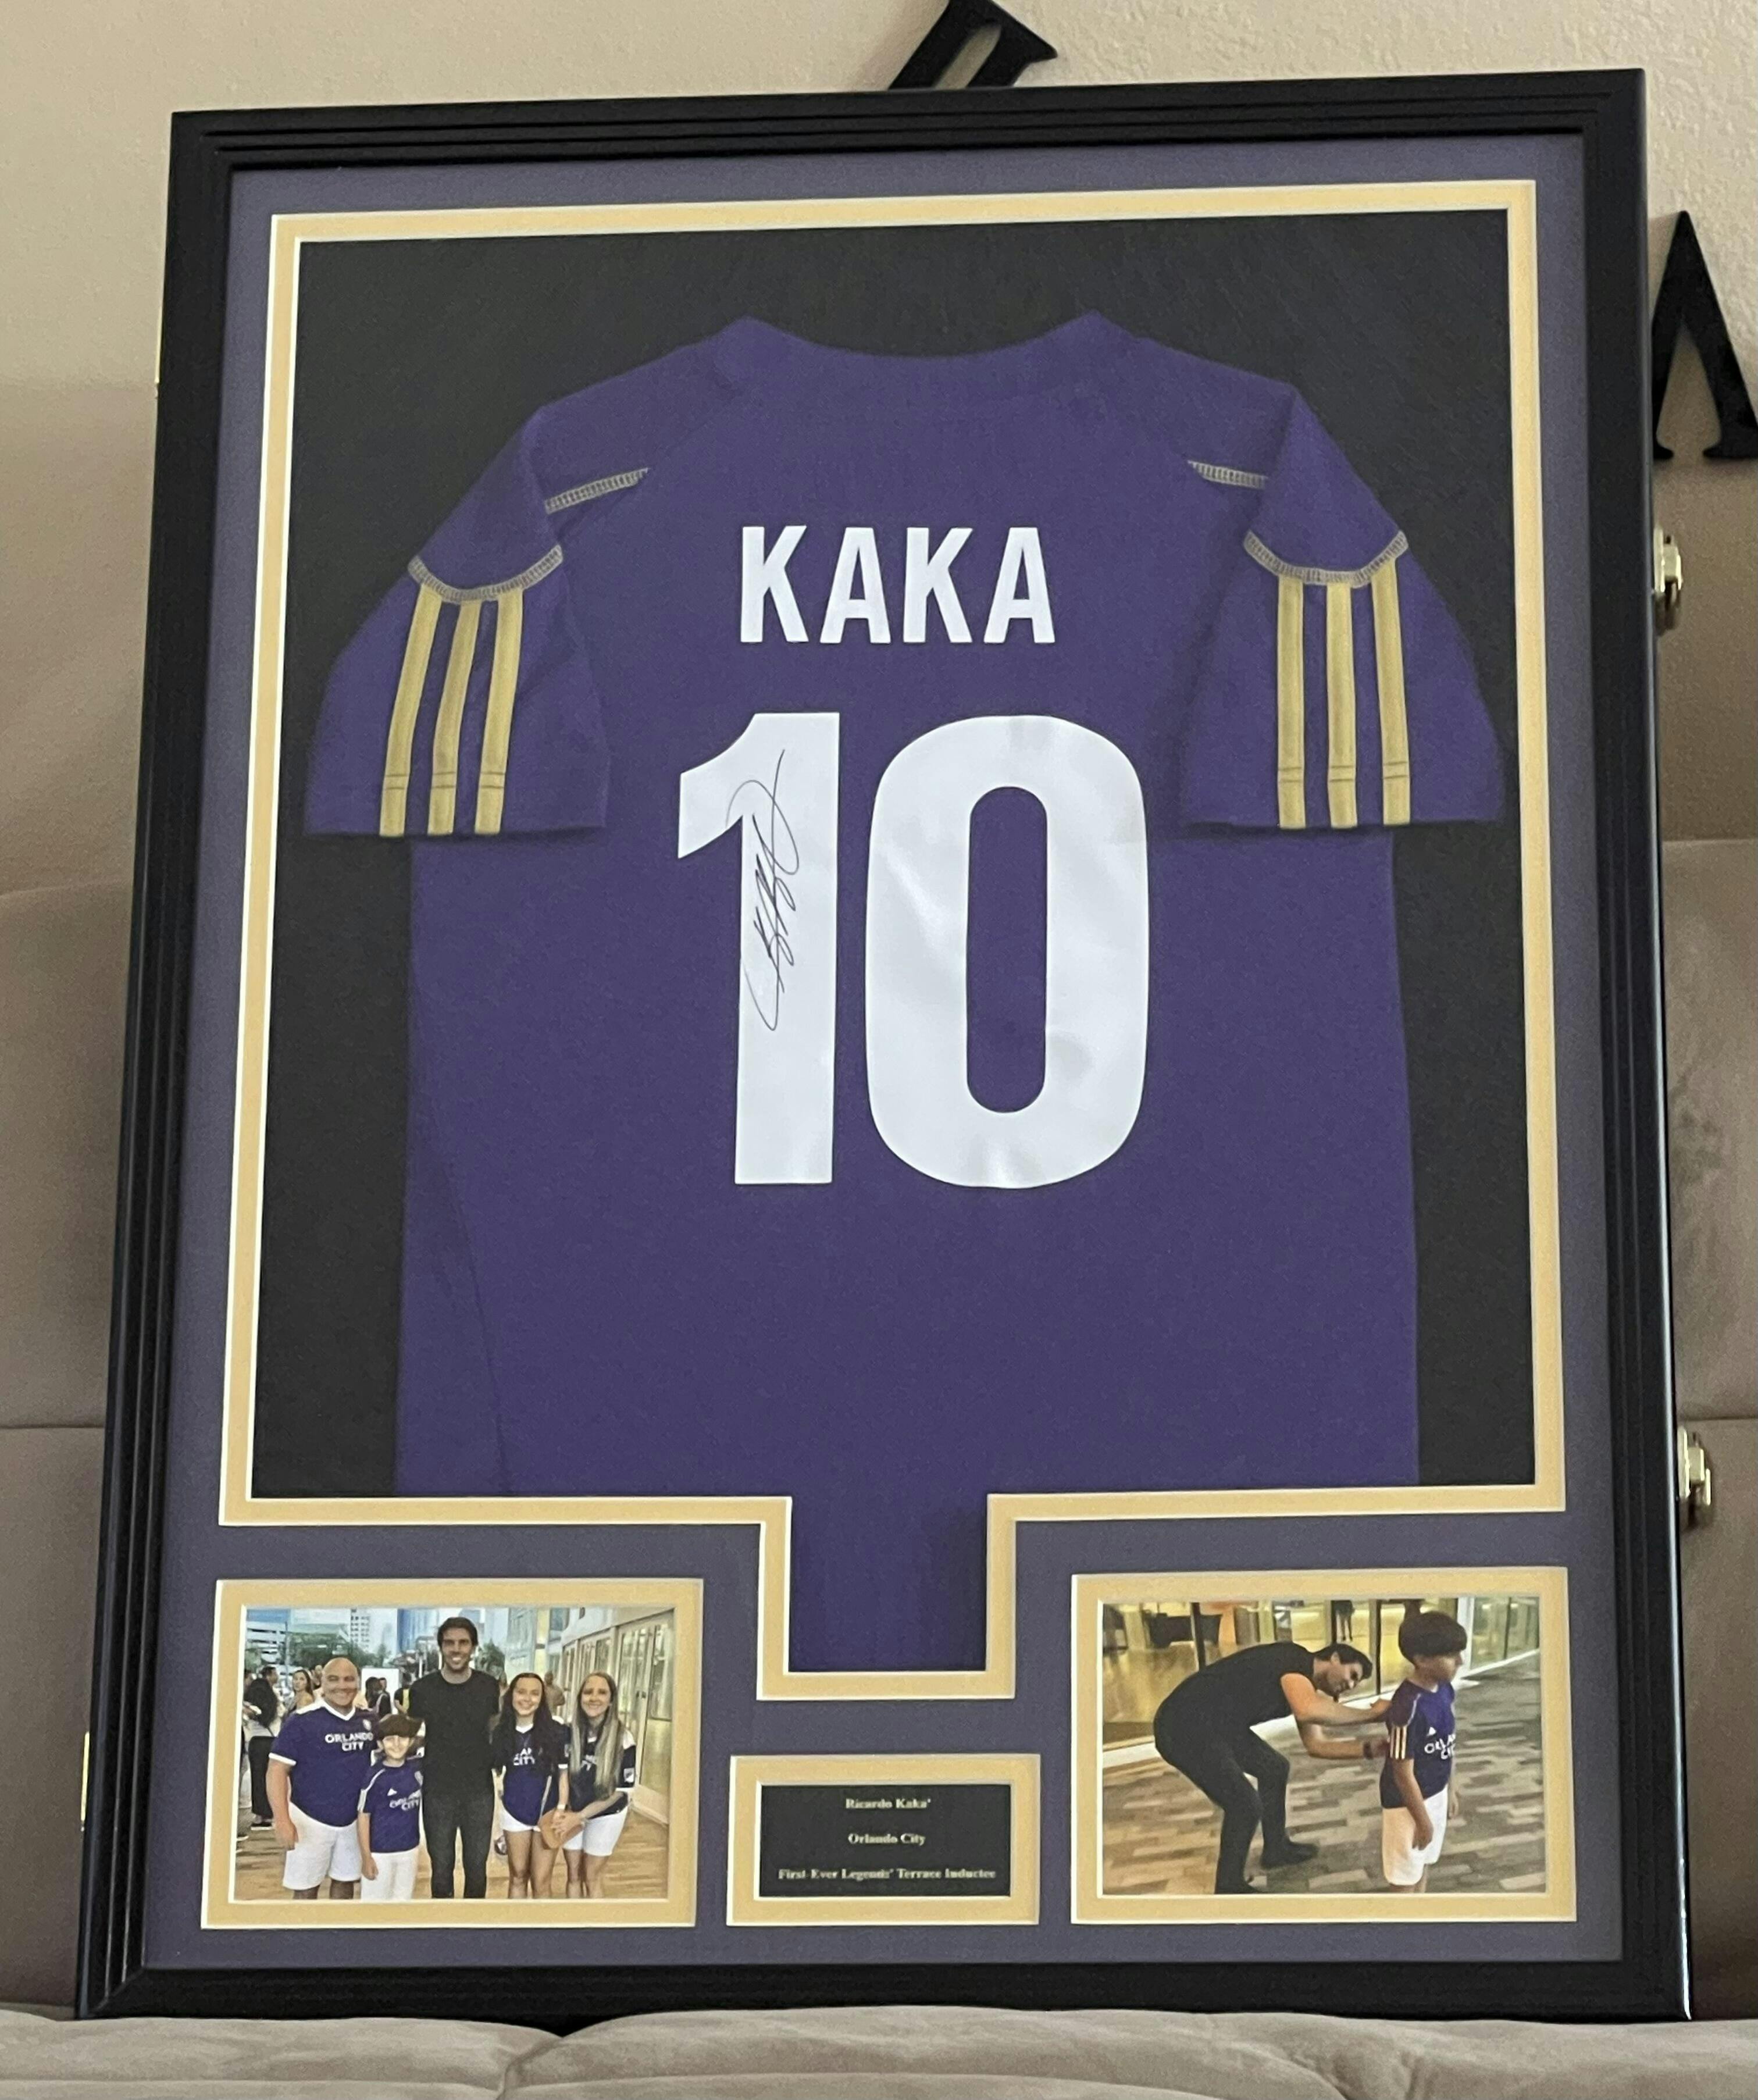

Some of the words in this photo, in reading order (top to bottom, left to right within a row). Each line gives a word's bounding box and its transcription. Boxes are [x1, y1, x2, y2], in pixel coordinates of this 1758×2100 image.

[740, 525, 1055, 643] KAKA
[678, 712, 1150, 1190] 10
[325, 1732, 374, 1744] ORLANDO
[341, 1741, 364, 1752] CITY
[846, 1798, 893, 1809] Ricardo
[848, 1833, 898, 1844] Orlando
[900, 1833, 926, 1846] City
[896, 1868, 942, 1879] Terrace
[944, 1868, 996, 1879] Inductee
